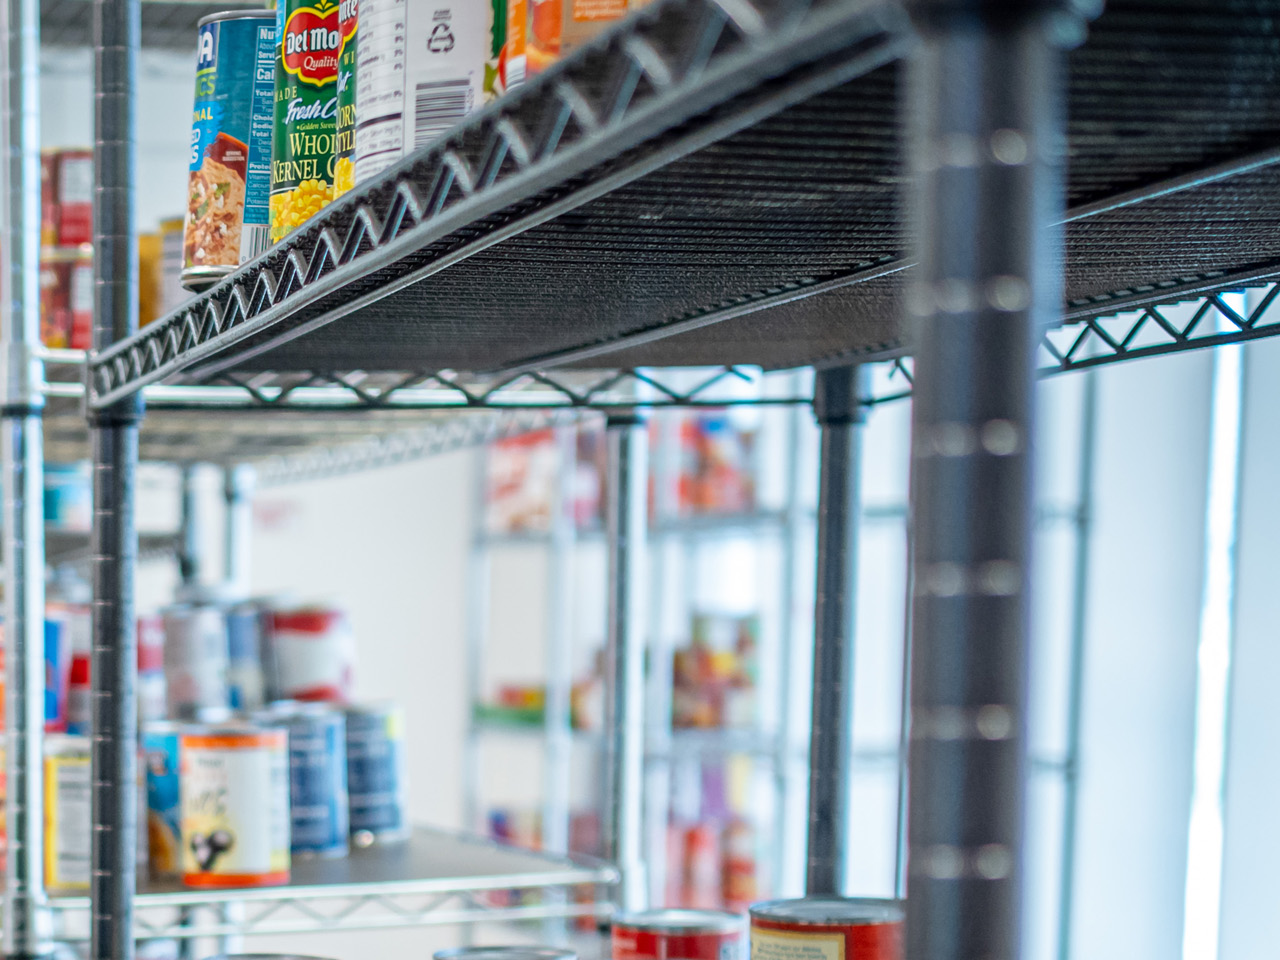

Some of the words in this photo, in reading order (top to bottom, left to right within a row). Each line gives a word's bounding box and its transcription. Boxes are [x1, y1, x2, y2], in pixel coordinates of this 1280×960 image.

[198, 31, 213, 63] A
[286, 27, 308, 55] Del
[310, 27, 339, 51] Mo
[304, 56, 338, 71] Quality
[286, 97, 321, 125] Fresh
[273, 159, 322, 184] KERNEL
